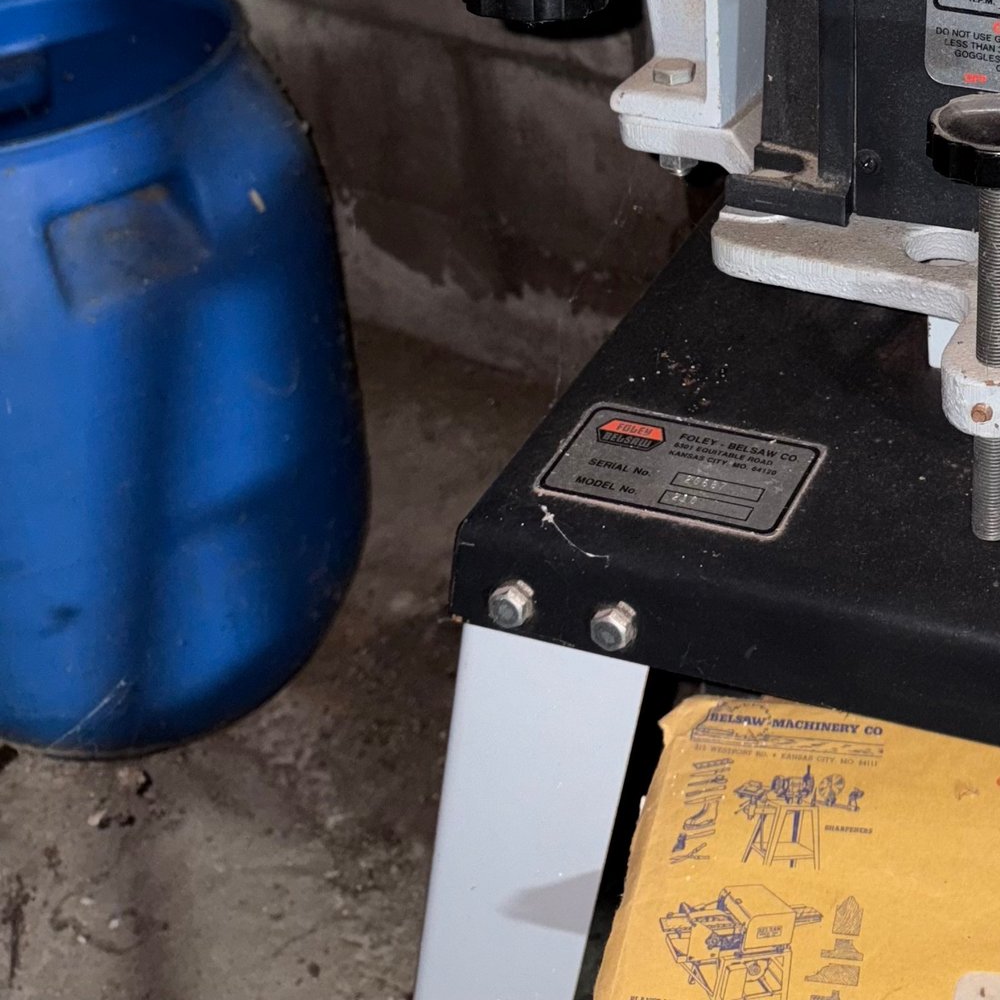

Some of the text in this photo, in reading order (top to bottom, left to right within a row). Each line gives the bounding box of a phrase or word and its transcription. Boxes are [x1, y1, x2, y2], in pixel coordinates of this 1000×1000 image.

[936, 27, 950, 36] DO
[952, 29, 971, 39] NOT
[973, 32, 992, 42] USE
[944, 38, 968, 49] LESS
[971, 42, 996, 53] THAN
[954, 49, 1000, 63] GOGGLES
[616, 423, 654, 435] FOLEY
[602, 431, 653, 447] BELSAW
[680, 433, 717, 446] FOLEY
[727, 442, 777, 458] BELSAW
[669, 450, 706, 462] KANSAS
[695, 446, 746, 461] EQUITABLE
[747, 456, 774, 466] ROAD
[588, 458, 651, 477] SERIAL No.
[575, 476, 638, 496] MODEL No.
[709, 712, 766, 727] BELSAW
[772, 718, 860, 734] MACHINERY
[781, 752, 814, 762] KANSAS
